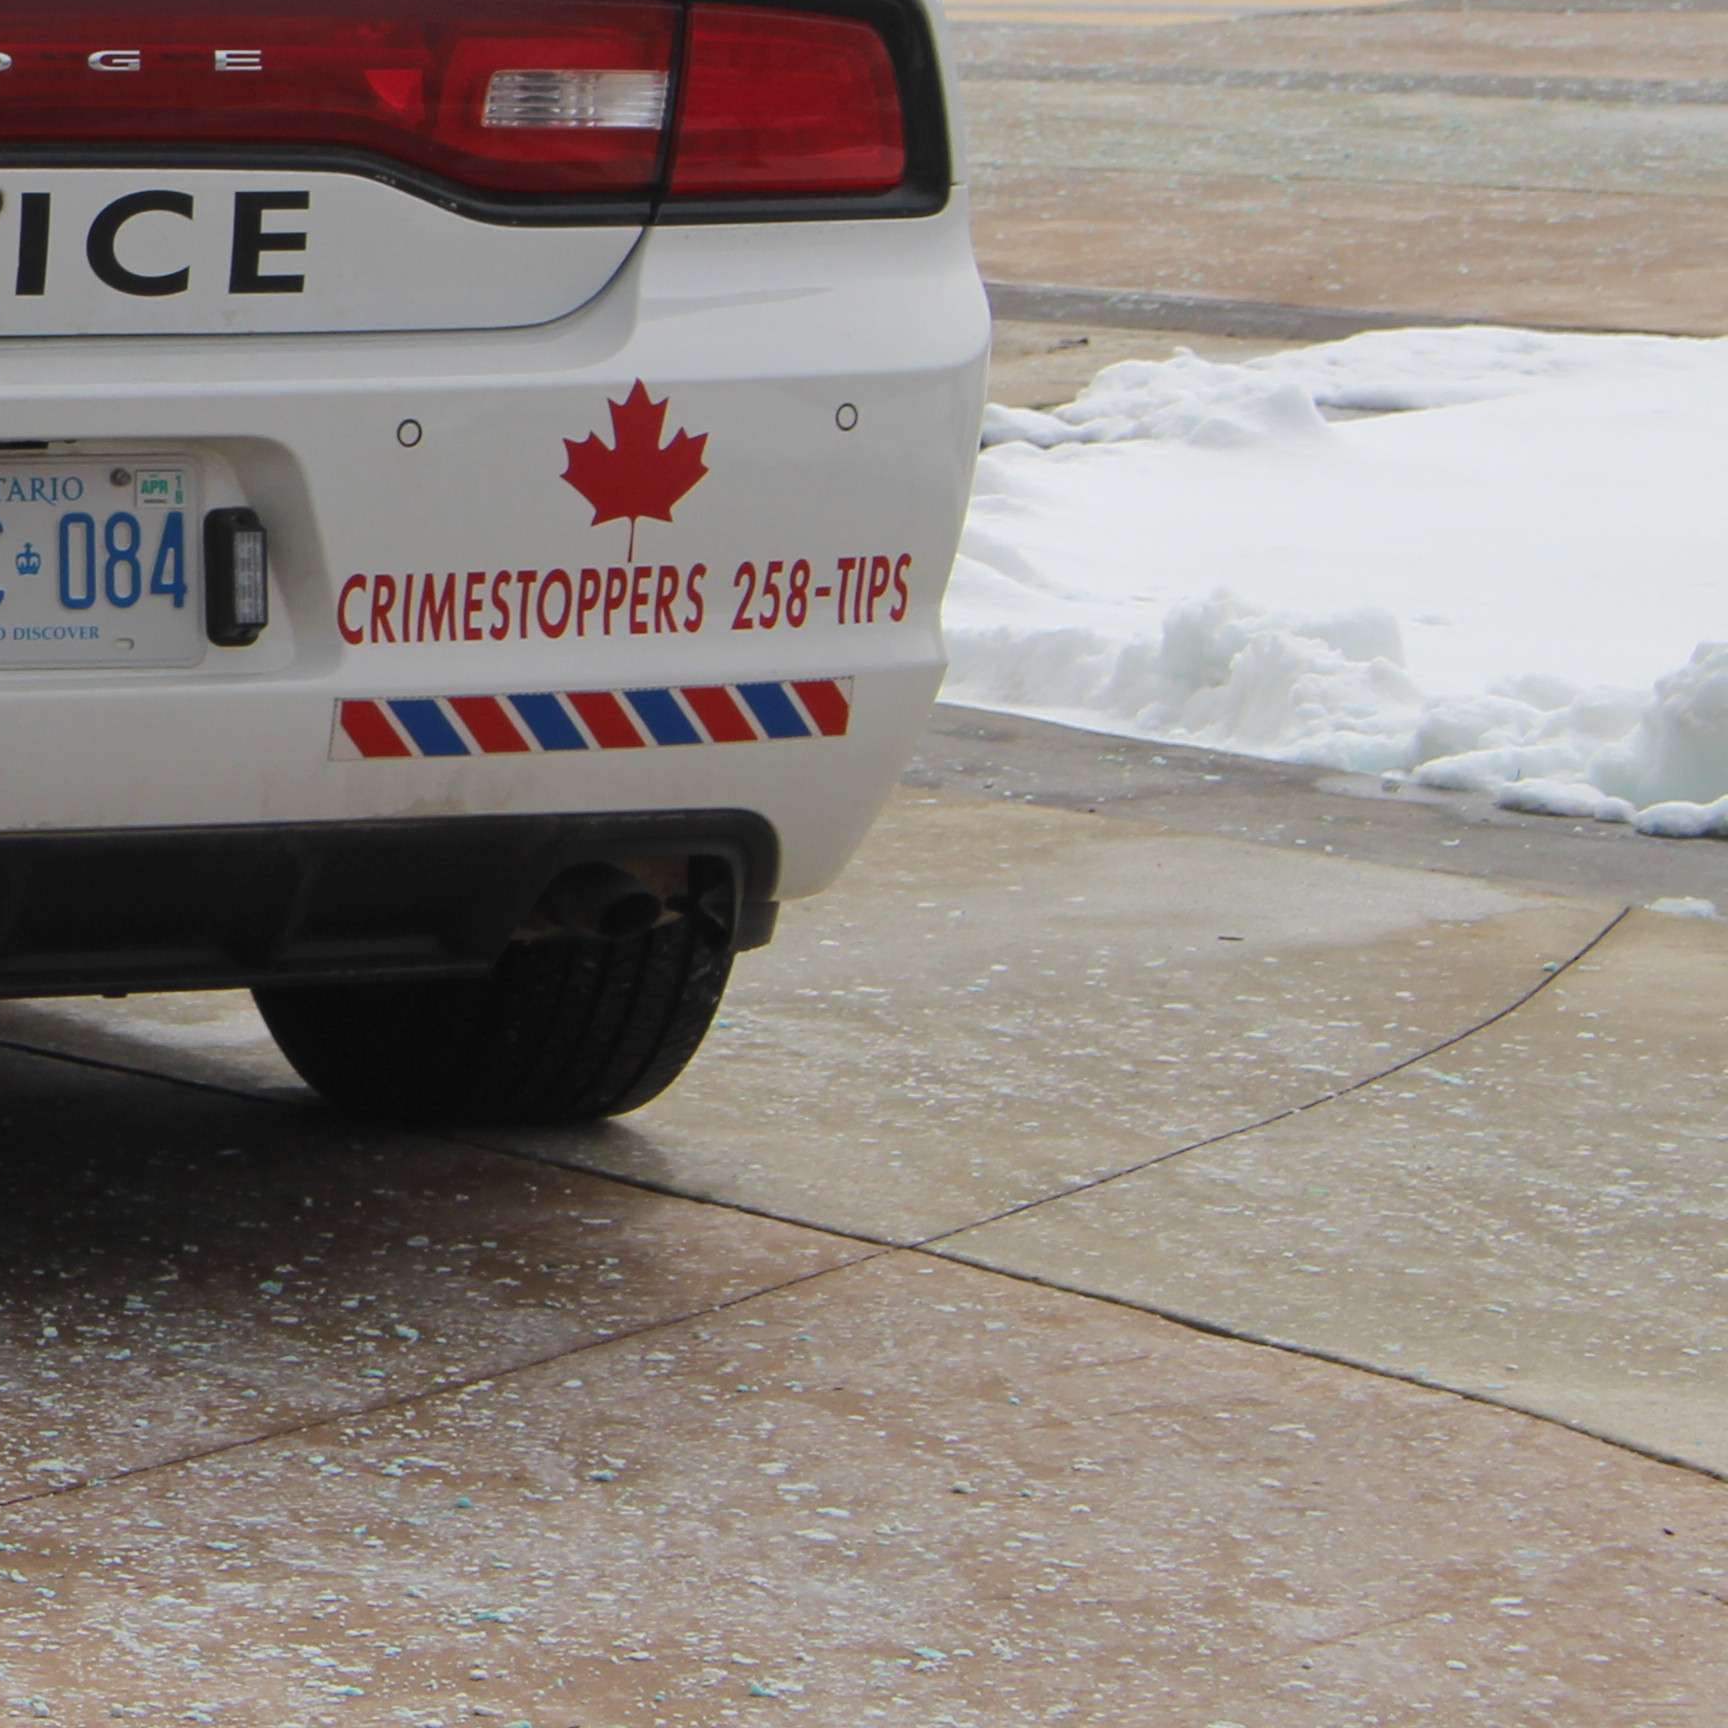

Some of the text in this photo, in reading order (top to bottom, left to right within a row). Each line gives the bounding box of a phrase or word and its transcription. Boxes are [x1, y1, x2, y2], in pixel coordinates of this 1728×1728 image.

[59, 511, 188, 609] 084
[337, 552, 913, 646] CRIMESTOPPERS 258-TIPS
[13, 626, 100, 641] DISCOVER
